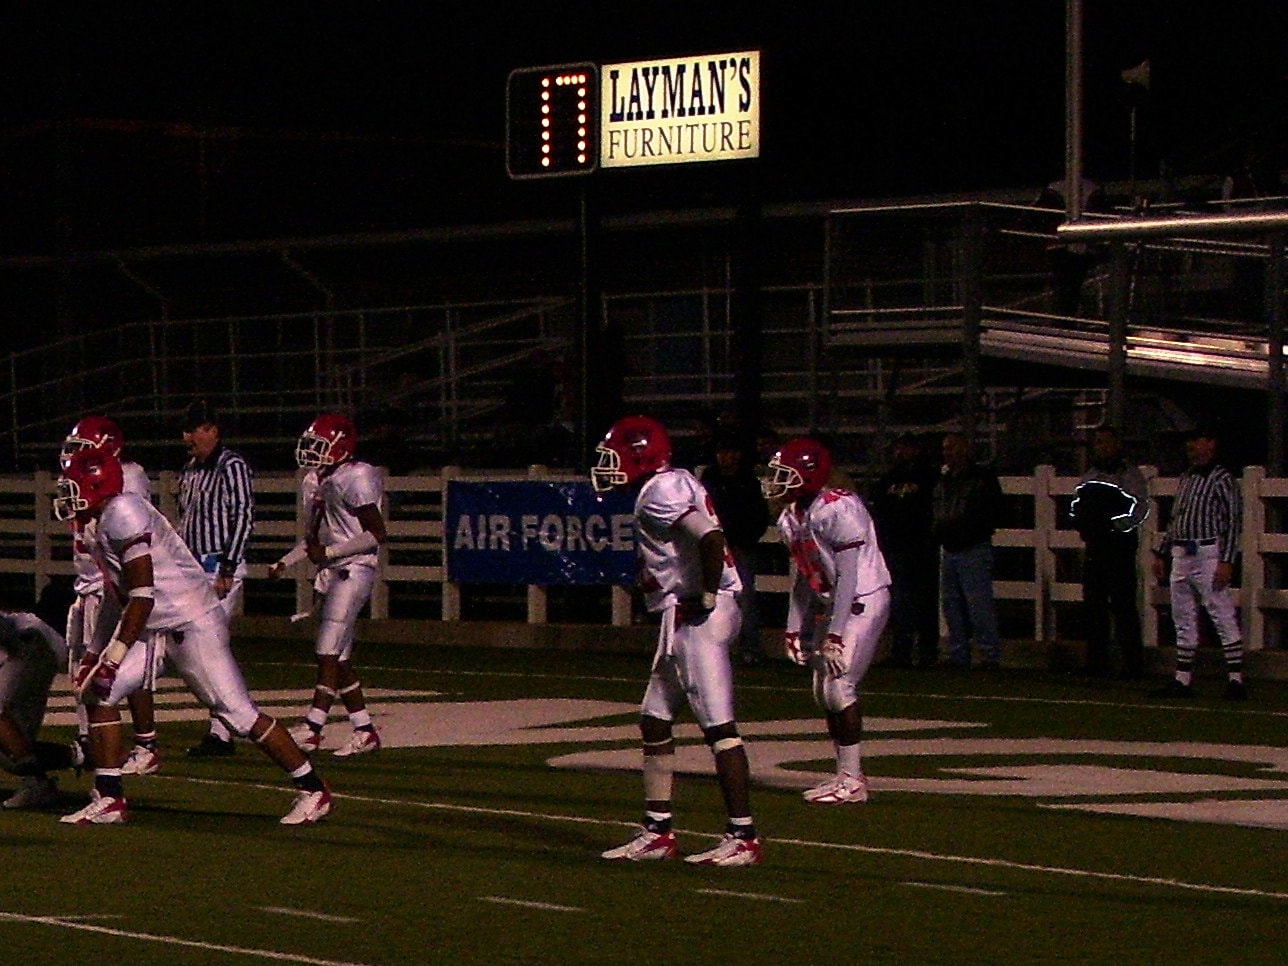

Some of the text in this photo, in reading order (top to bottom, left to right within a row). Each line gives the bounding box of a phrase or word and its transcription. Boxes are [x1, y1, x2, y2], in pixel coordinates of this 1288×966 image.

[610, 57, 751, 122] LAYMAN'S
[608, 119, 751, 160] FURNITURE
[454, 513, 637, 551] AIR FORCE
